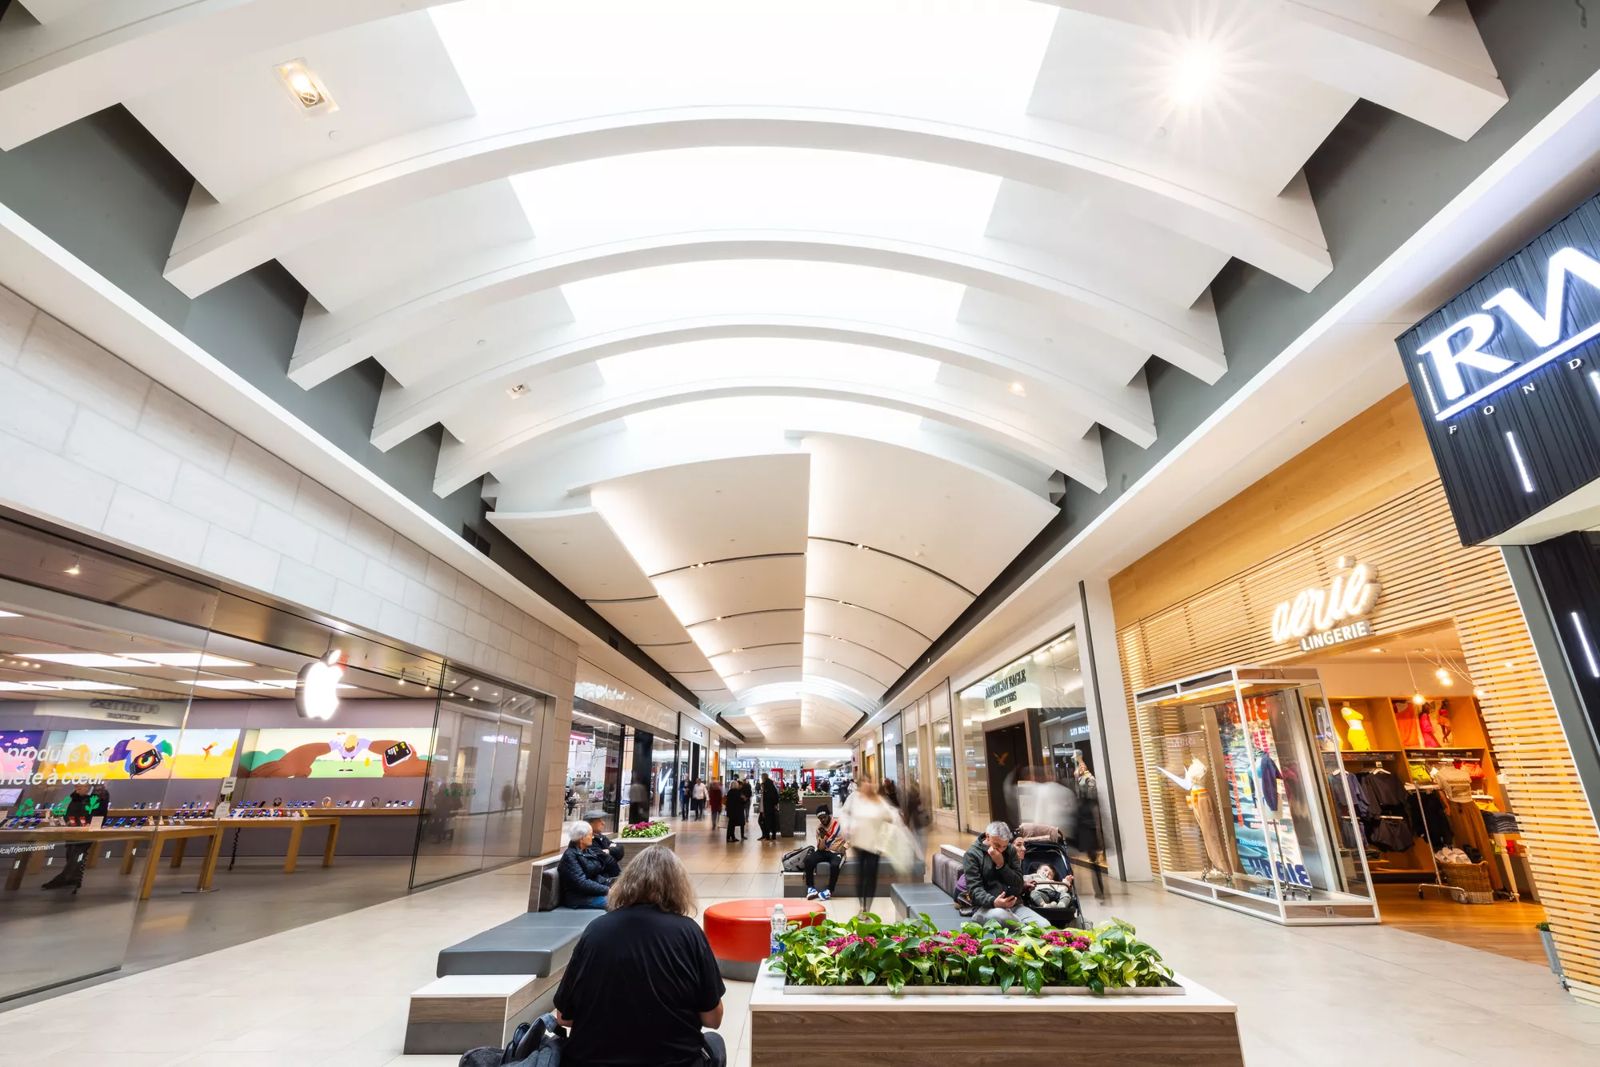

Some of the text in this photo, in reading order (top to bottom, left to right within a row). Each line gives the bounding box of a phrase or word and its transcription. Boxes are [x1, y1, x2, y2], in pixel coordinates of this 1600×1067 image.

[1271, 554, 1378, 643] aerie
[1300, 620, 1368, 651] LINGERIE
[46, 767, 59, 785] à
